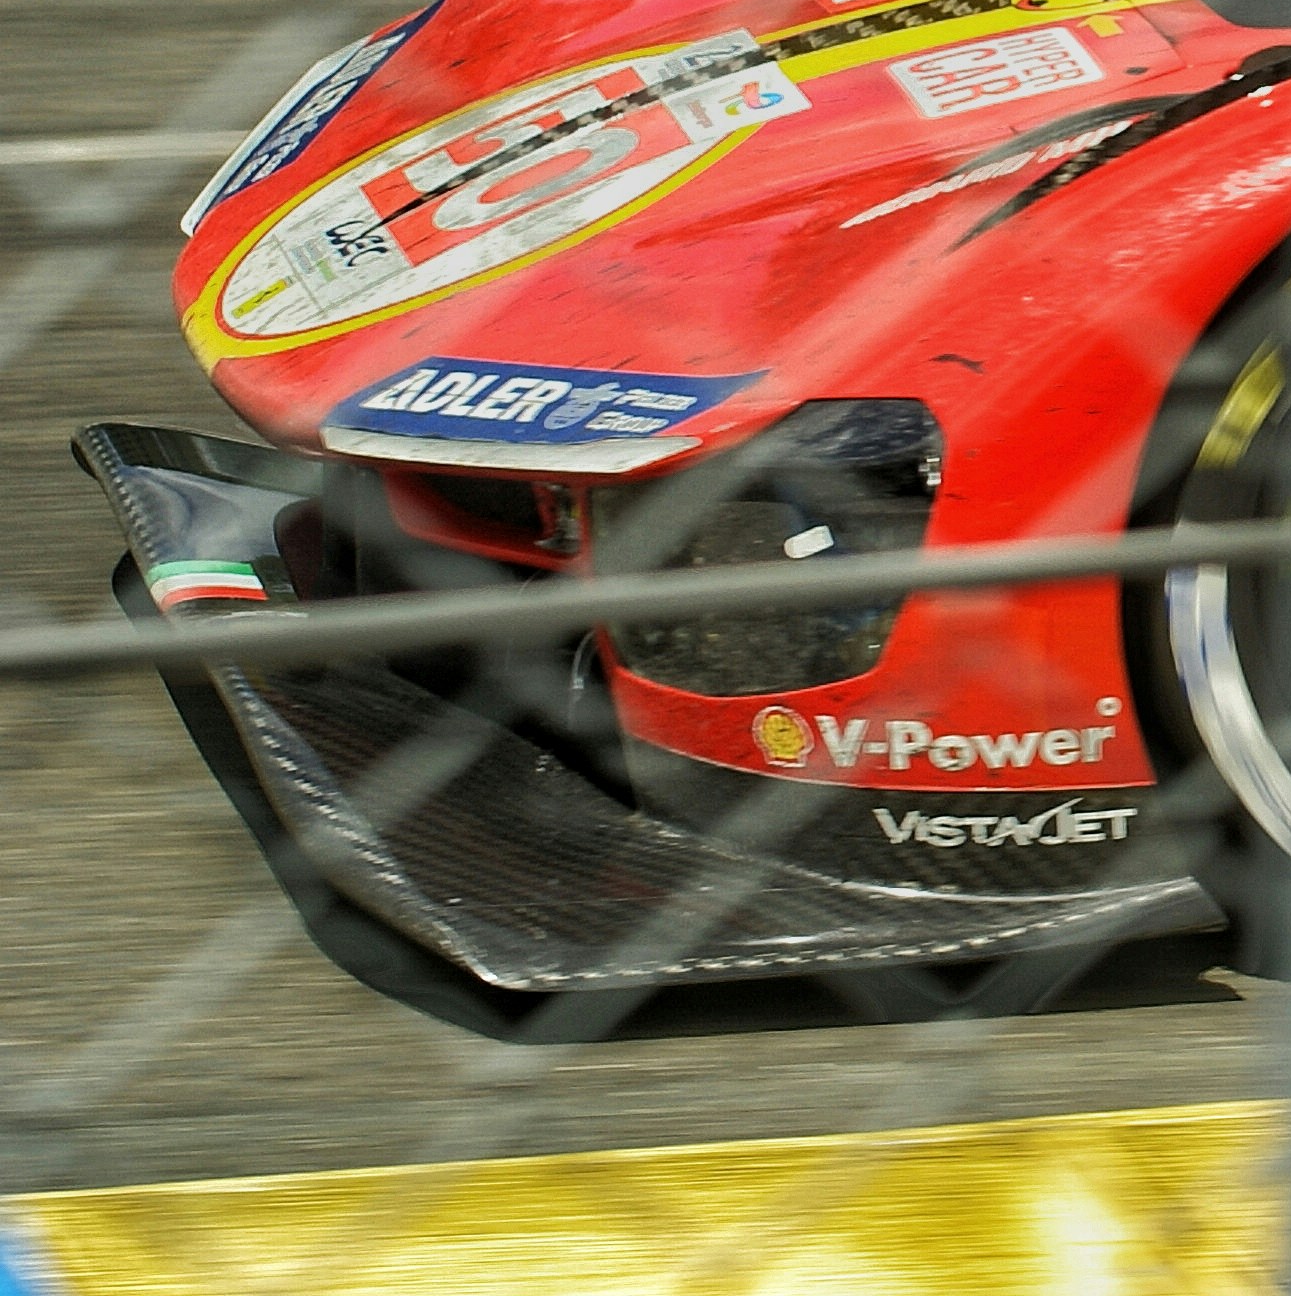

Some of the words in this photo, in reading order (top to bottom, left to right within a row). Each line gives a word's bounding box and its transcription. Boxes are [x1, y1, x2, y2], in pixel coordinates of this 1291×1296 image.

[907, 47, 1023, 112] CAR
[998, 32, 1087, 89] HYPER
[360, 369, 573, 422] ADLER
[814, 713, 1116, 771] V-Power
